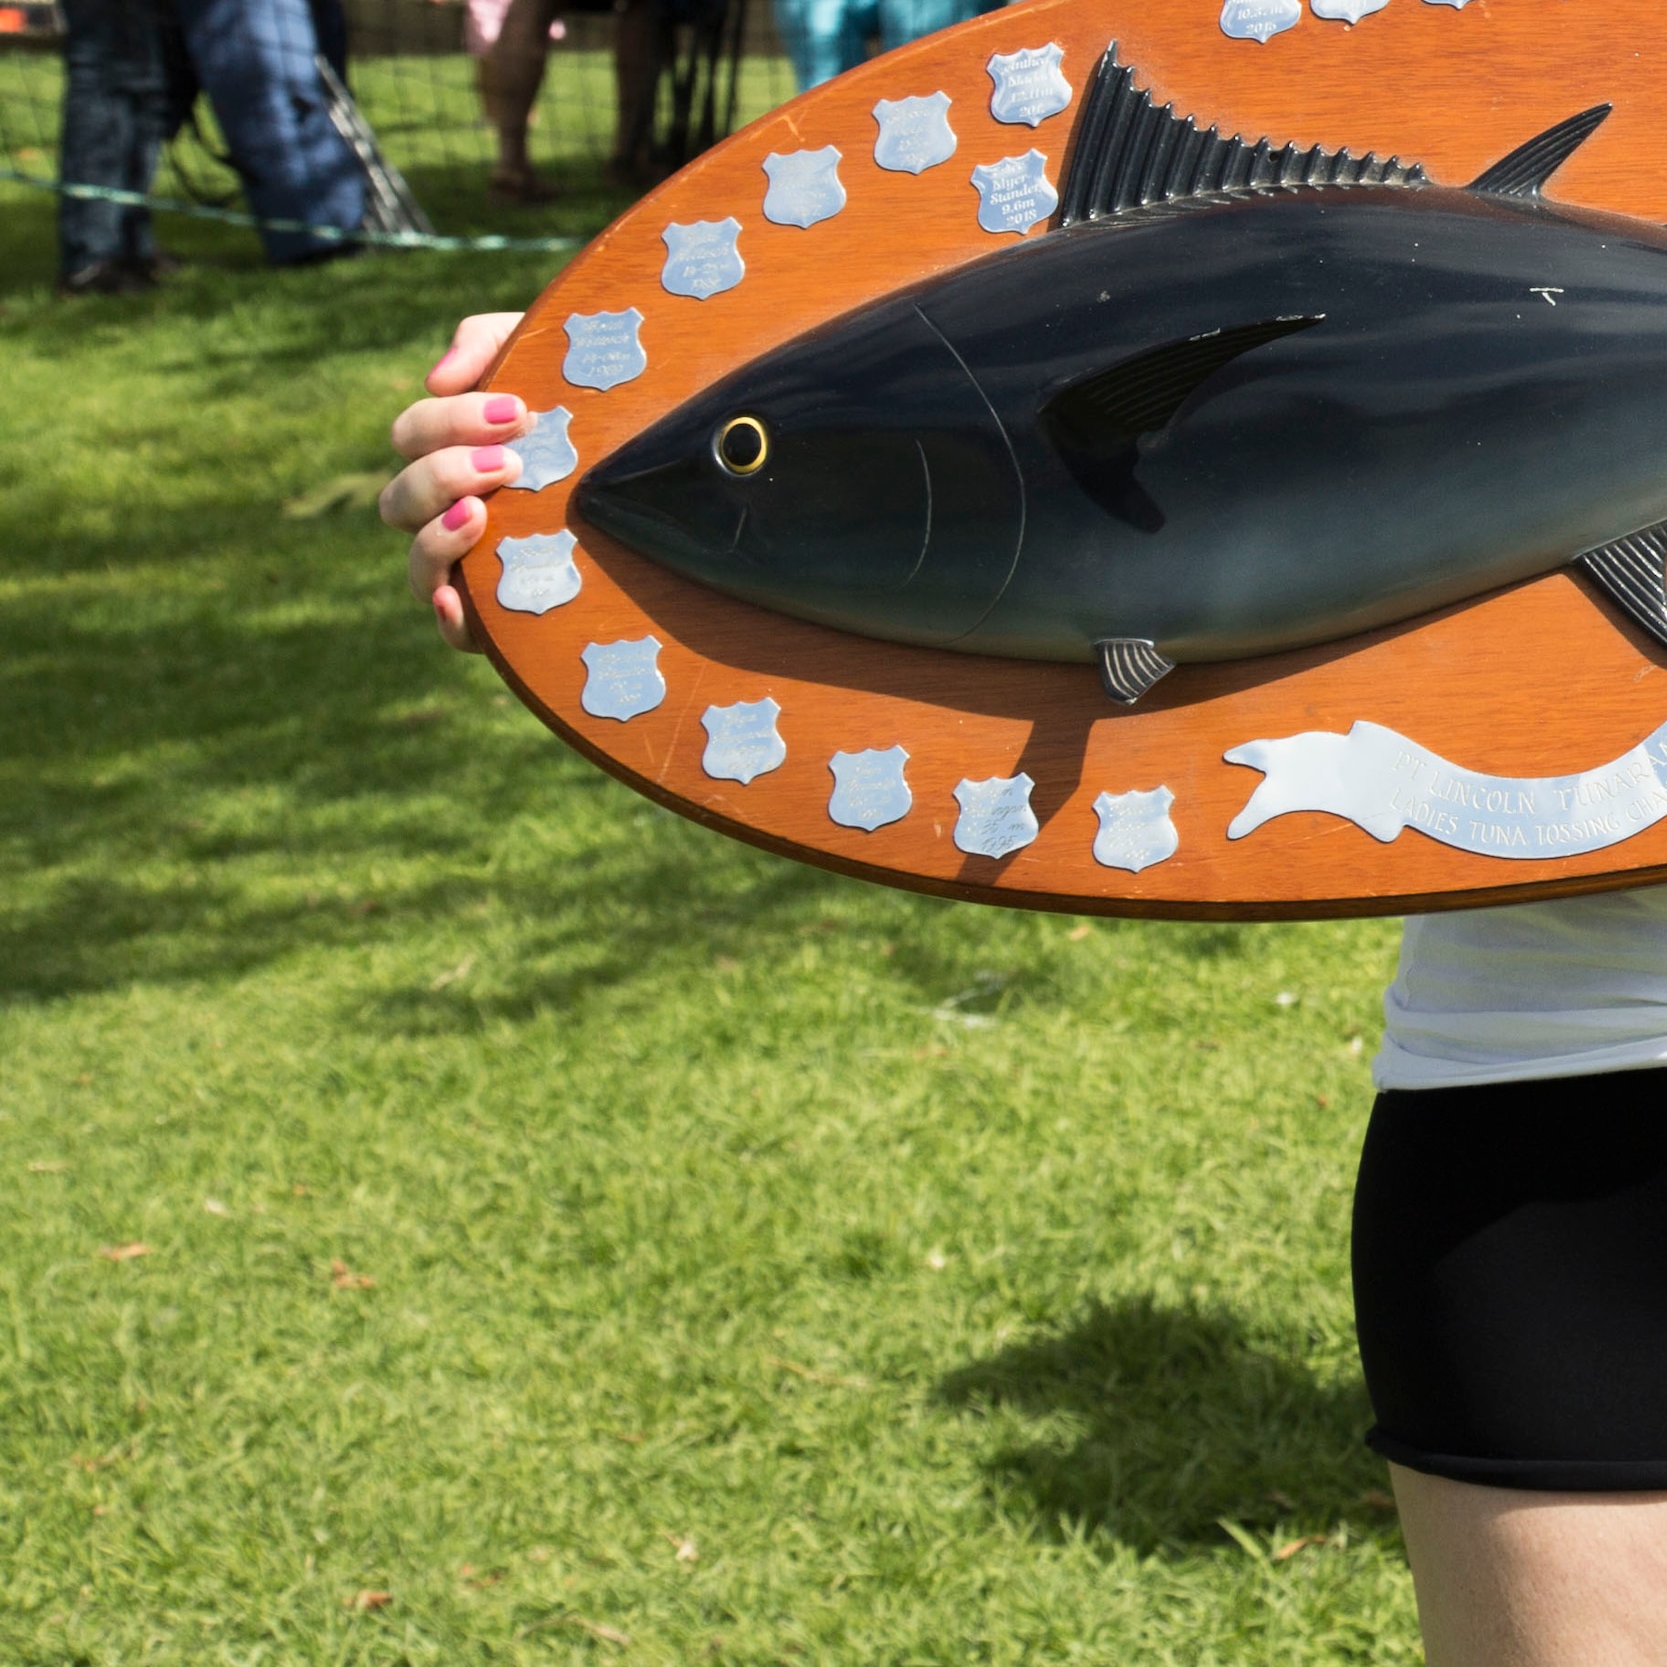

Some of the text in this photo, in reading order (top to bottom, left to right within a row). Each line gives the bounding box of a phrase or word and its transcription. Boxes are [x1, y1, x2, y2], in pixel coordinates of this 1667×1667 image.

[1001, 200, 1035, 215] 9.6m
[1006, 210, 1037, 228] 2018
[1390, 750, 1428, 783] PT
[1428, 771, 1538, 816] LINCOLN
[1388, 788, 1459, 836] LADIES
[1470, 820, 1530, 847] TUNA
[1535, 812, 1622, 847] TOSSING
